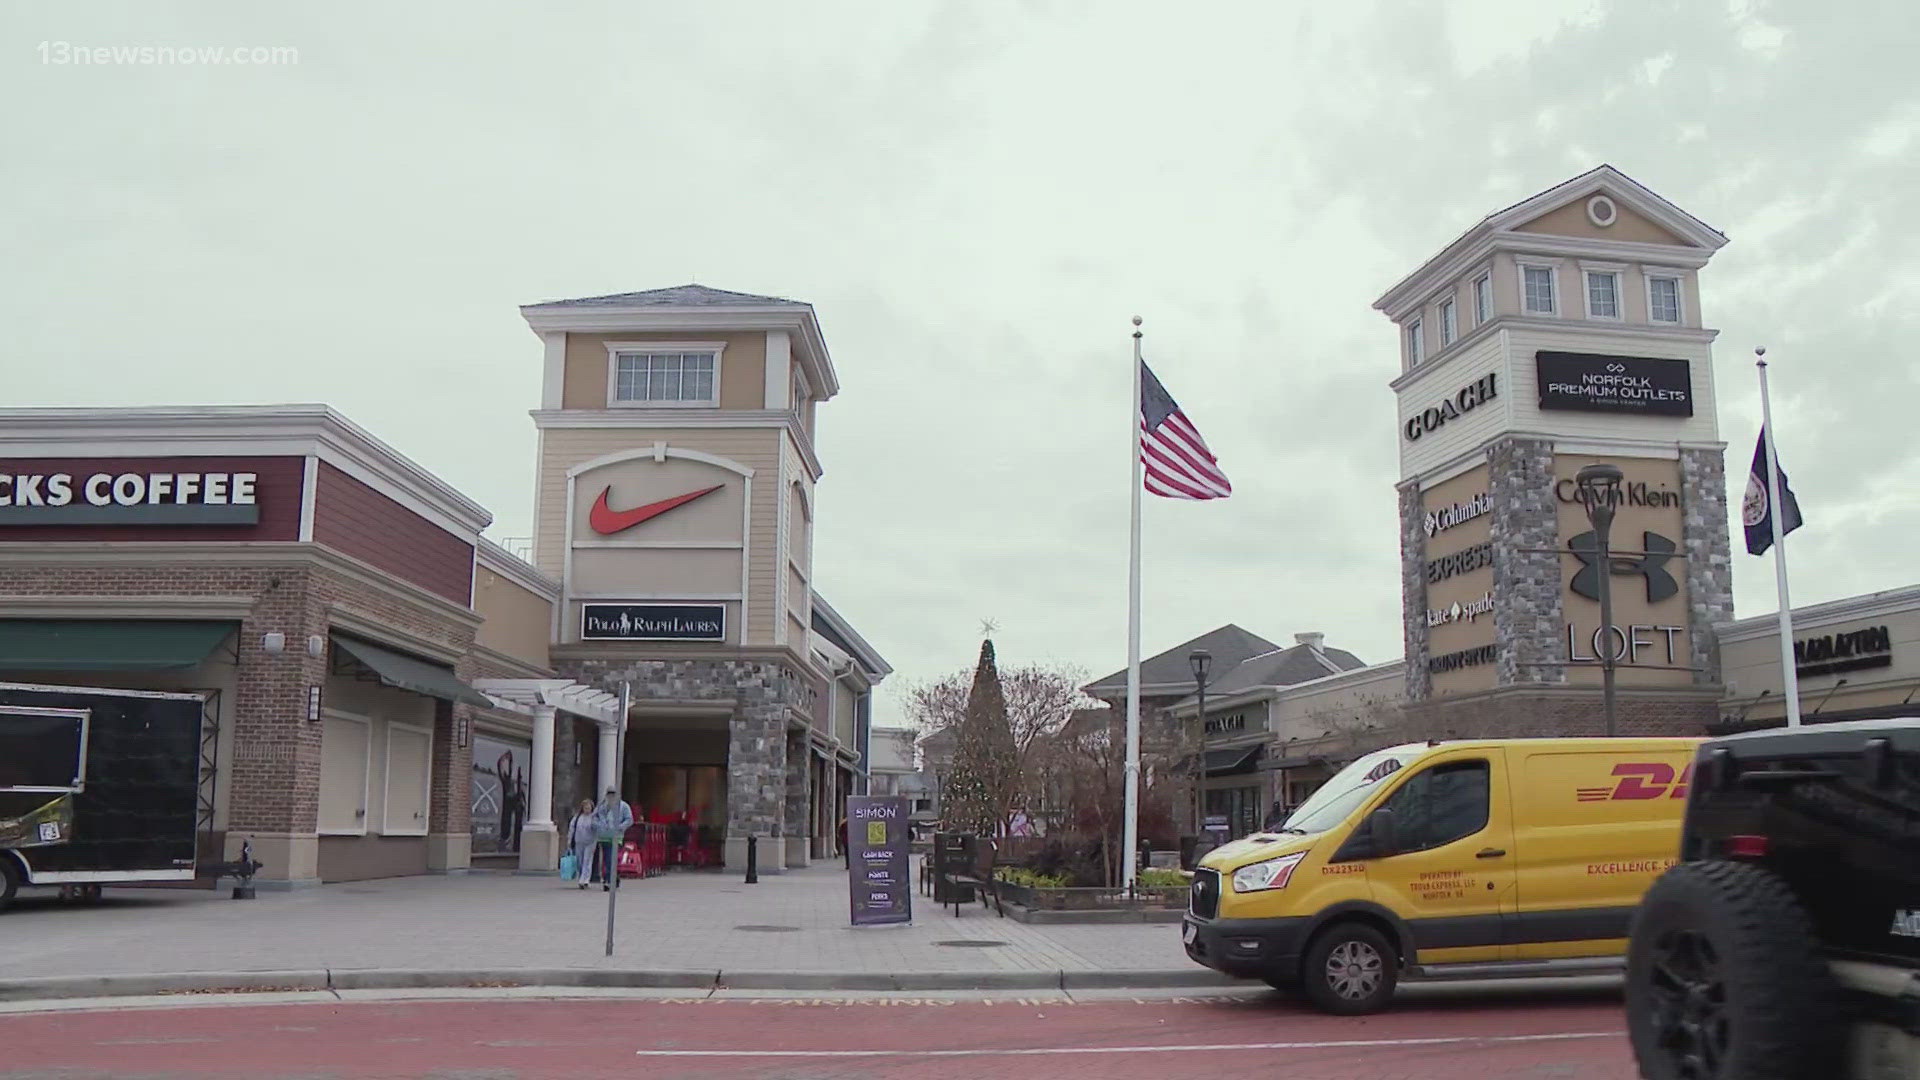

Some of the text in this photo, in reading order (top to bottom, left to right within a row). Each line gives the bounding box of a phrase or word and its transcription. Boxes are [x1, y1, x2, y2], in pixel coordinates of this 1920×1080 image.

[1549, 383, 1686, 402] PREMIUM OUTLETS
[1582, 373, 1652, 388] NORFOLK
[1404, 373, 1497, 441] COACH
[85, 473, 257, 506] COFFEE
[1556, 478, 1679, 508] Cavn Klein
[1436, 493, 1494, 531] Columbia
[1428, 543, 1493, 584] EXPRESS
[588, 616, 720, 633] POLO RALPH LAUREN
[1426, 608, 1450, 628] kate
[1568, 624, 1684, 664] LOFT
[855, 807, 896, 819] SIMON
[1587, 861, 1661, 875] EXCELLENCE.
